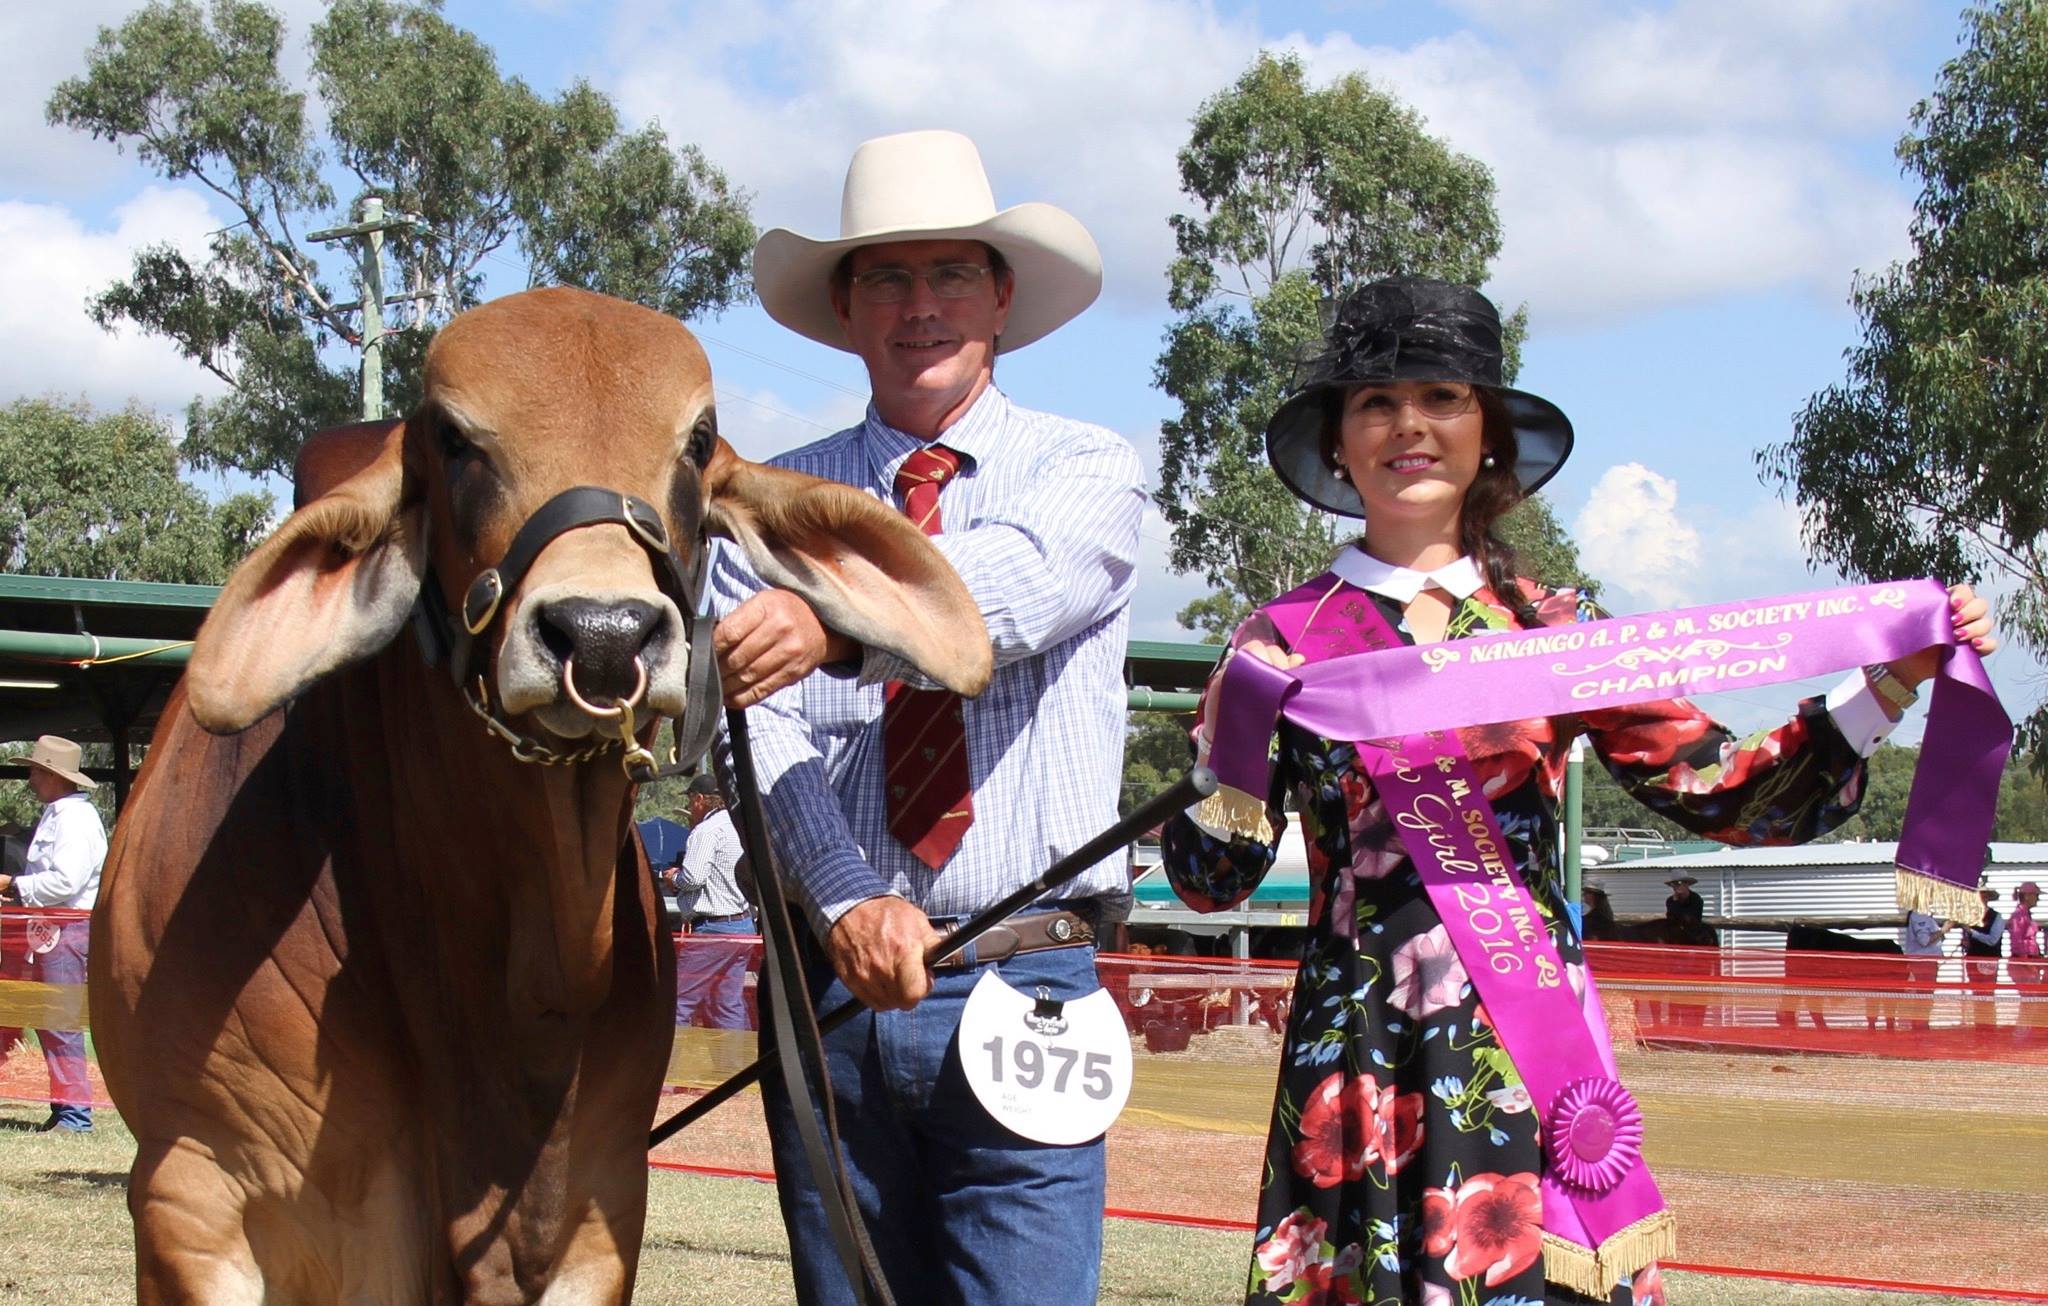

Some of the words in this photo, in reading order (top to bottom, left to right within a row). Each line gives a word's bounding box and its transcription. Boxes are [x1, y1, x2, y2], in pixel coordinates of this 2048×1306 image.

[1470, 631, 1585, 663] NANANGO
[1589, 628, 1615, 648] A.
[1620, 624, 1641, 644] P.
[1647, 621, 1667, 640] &
[1673, 617, 1703, 635] M.
[1707, 600, 1813, 632] SOCIETY
[1816, 596, 1865, 618] INC.
[1570, 655, 1787, 700] CHAMPION
[1396, 793, 1479, 875] Girl
[1453, 881, 1523, 975] 2016
[1434, 754, 1456, 773] &
[1445, 777, 1471, 806] M.
[1461, 808, 1521, 903] SOCIETY
[1508, 906, 1539, 953] INC.
[982, 1035, 1113, 1101] 1975
